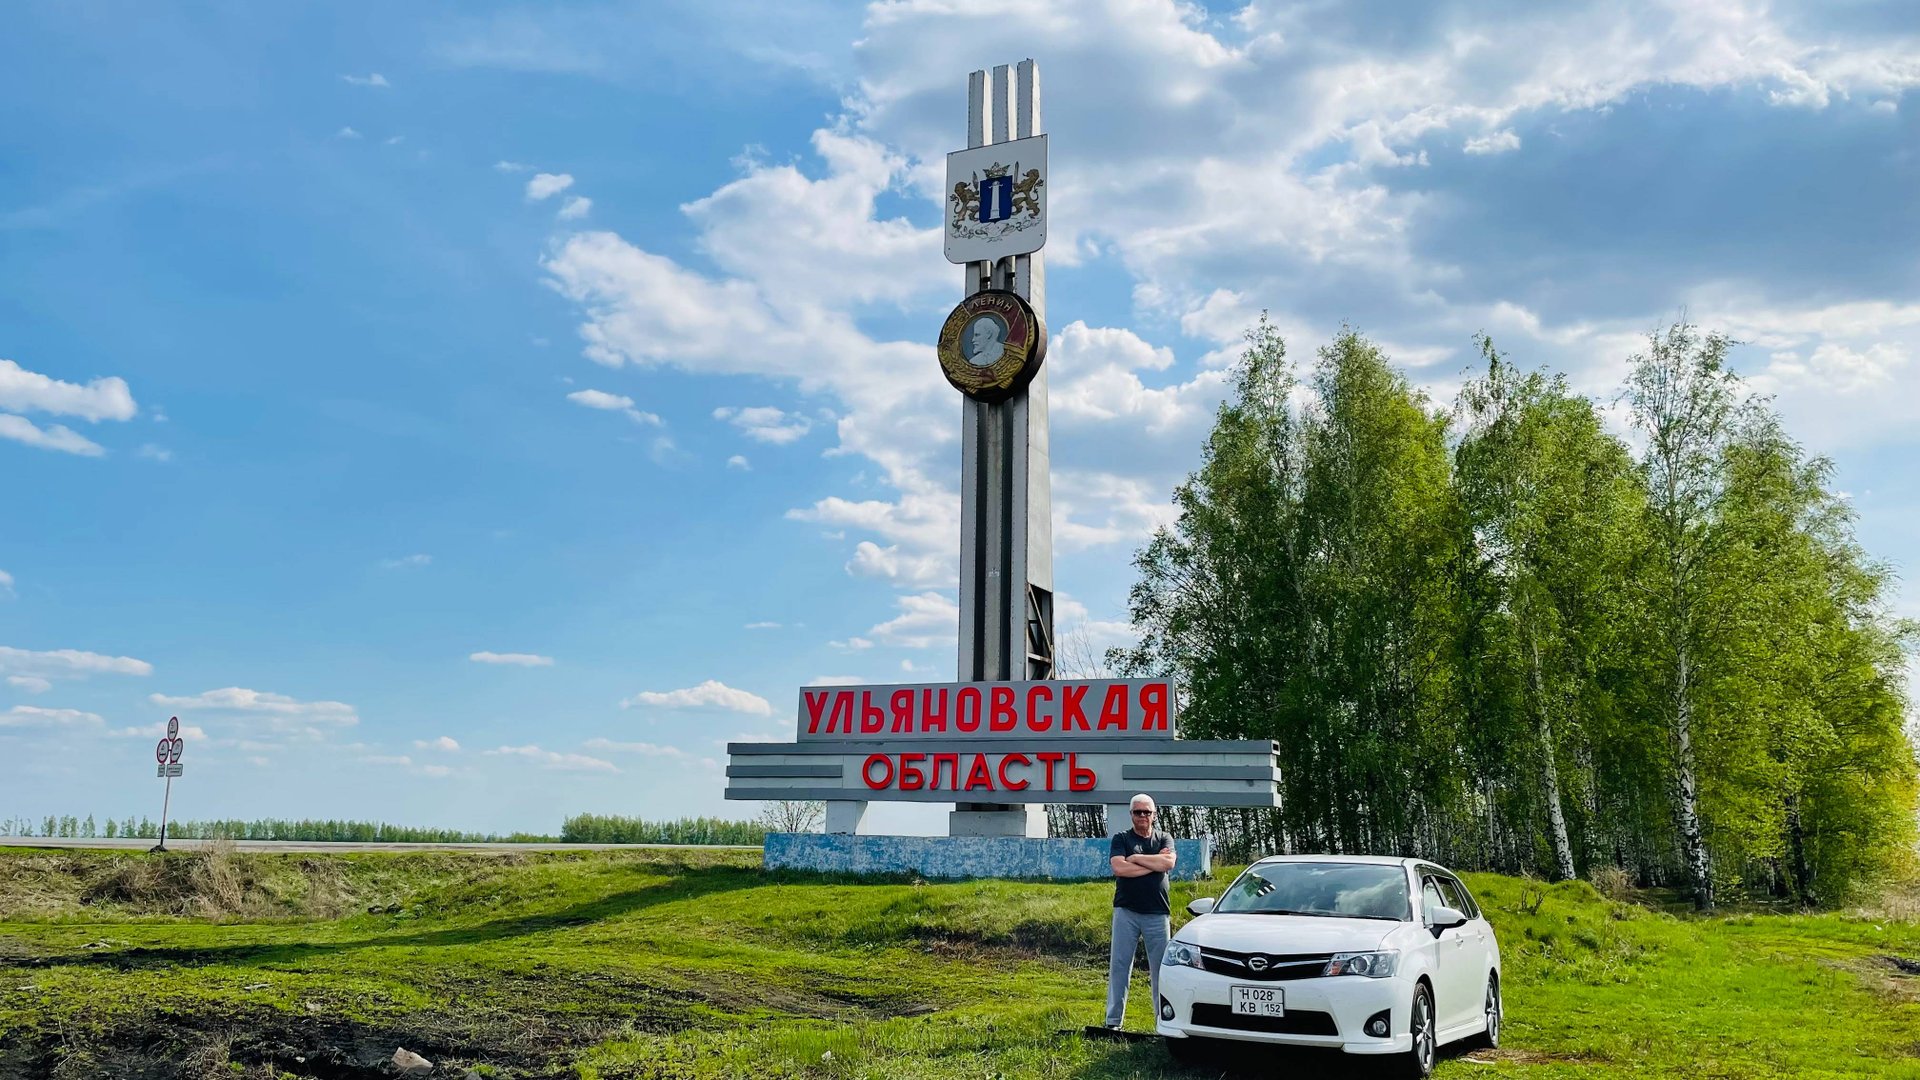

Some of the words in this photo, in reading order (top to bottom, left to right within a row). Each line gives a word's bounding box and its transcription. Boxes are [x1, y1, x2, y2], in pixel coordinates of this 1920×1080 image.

[971, 297, 1012, 311] ЛЕНИН
[804, 683, 1168, 734] УЛЬЯНОВСКАЯ
[862, 752, 1098, 792] ОБЛАСТЬ
[1253, 989, 1273, 1001] 028
[1265, 1003, 1281, 1013] 152
